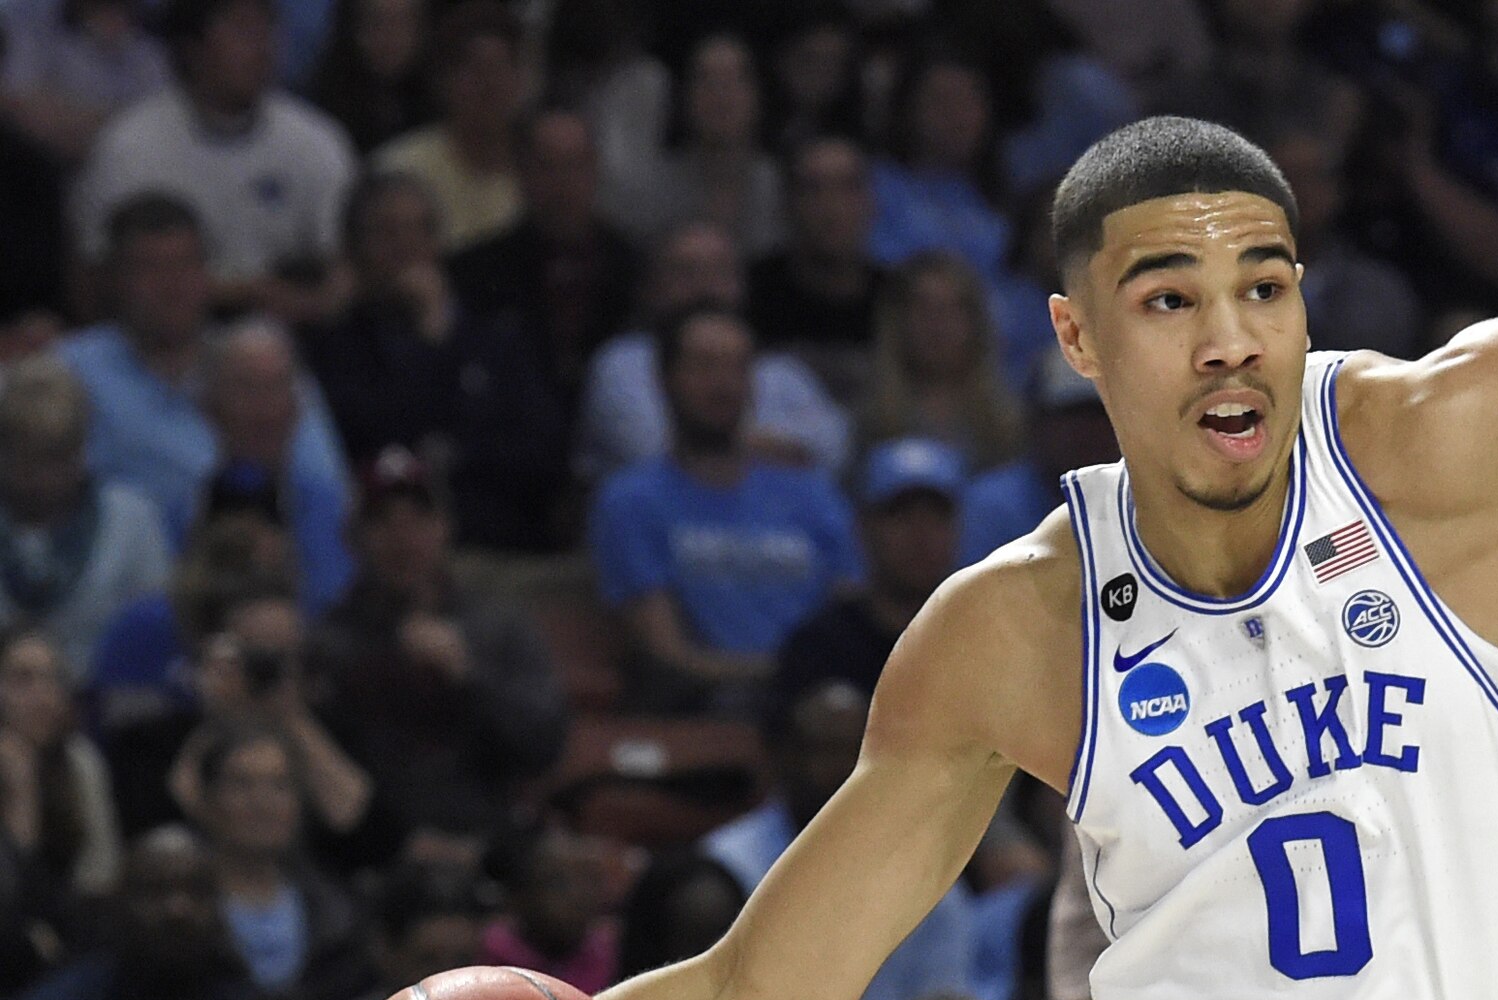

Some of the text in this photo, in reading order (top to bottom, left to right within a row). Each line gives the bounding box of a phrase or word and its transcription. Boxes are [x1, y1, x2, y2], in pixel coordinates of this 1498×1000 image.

[1108, 584, 1133, 608] KB
[1352, 602, 1392, 626] ACC
[1130, 693, 1187, 720] NCAA
[1129, 670, 1426, 850] DUKE
[1246, 811, 1373, 980] 0
